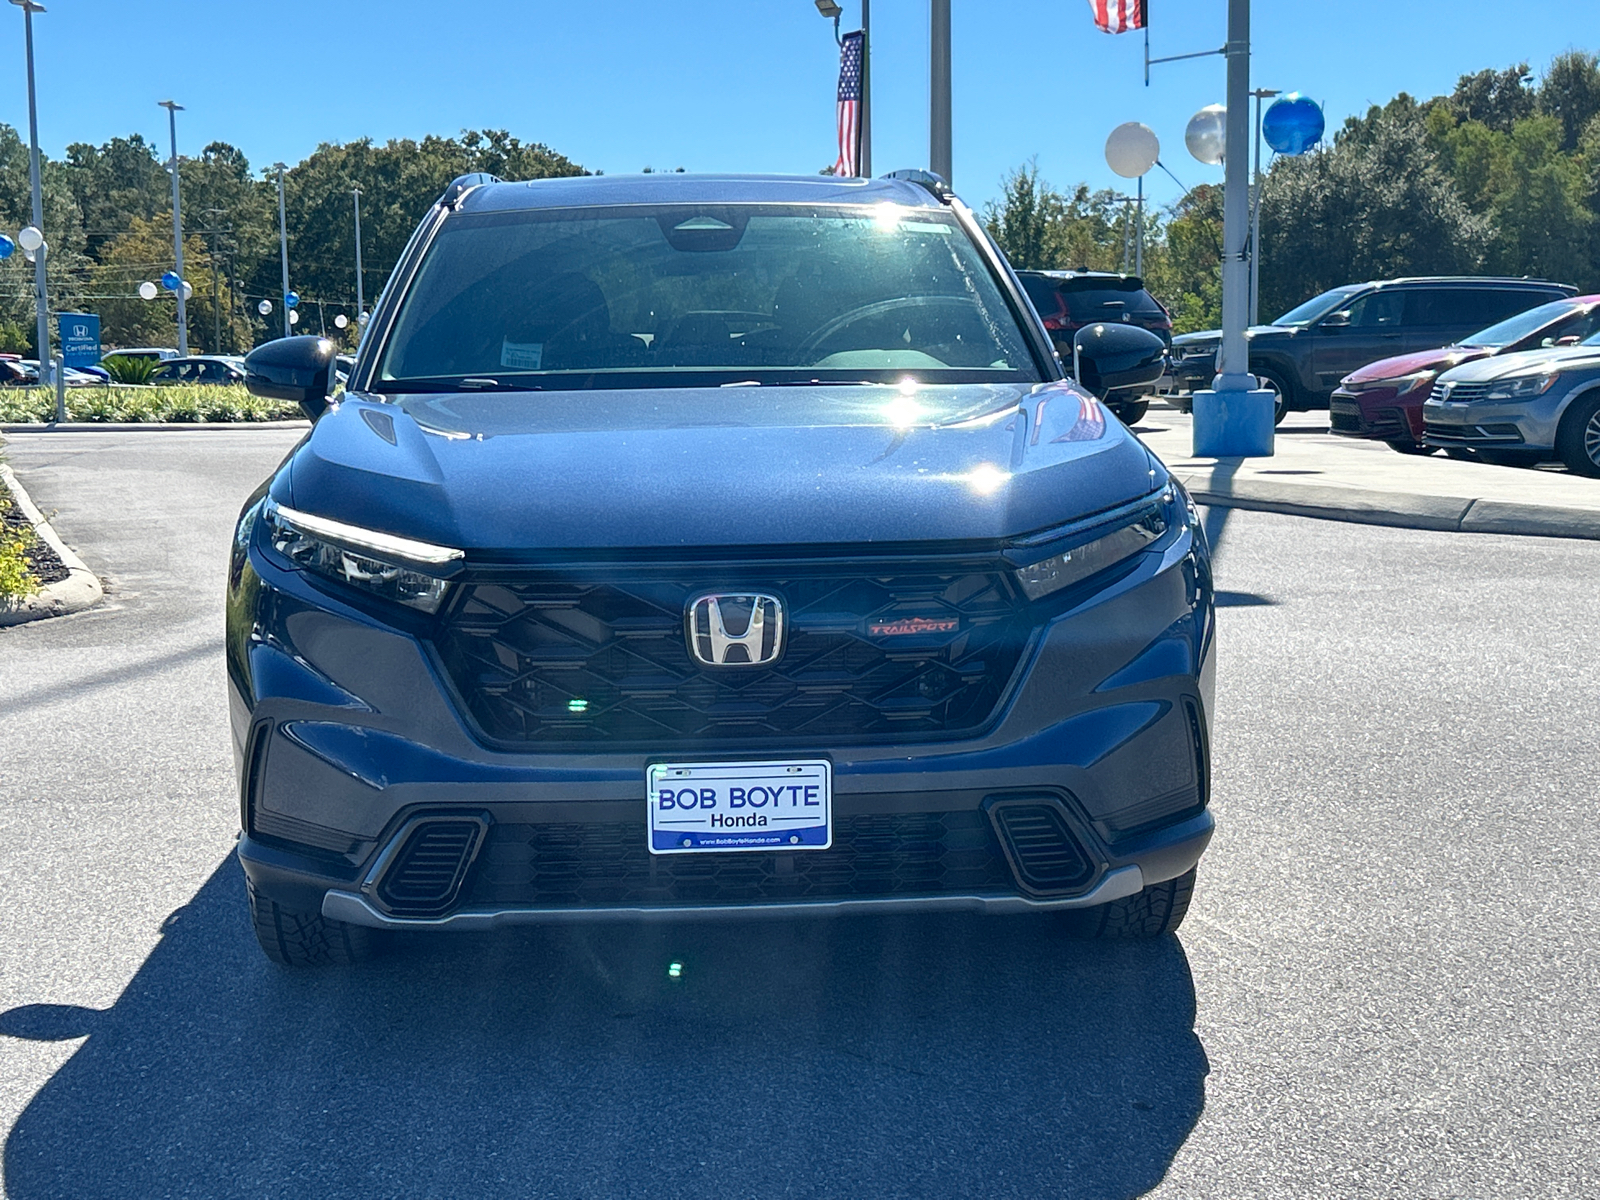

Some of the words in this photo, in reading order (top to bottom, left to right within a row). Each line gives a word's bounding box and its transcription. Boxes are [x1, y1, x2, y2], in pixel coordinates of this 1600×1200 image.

[65, 344, 98, 352] Certified
[871, 621, 957, 635] TRAILSPORT
[659, 788, 717, 810] BOB
[729, 785, 820, 809] BOYTE
[711, 812, 768, 828] Honda
